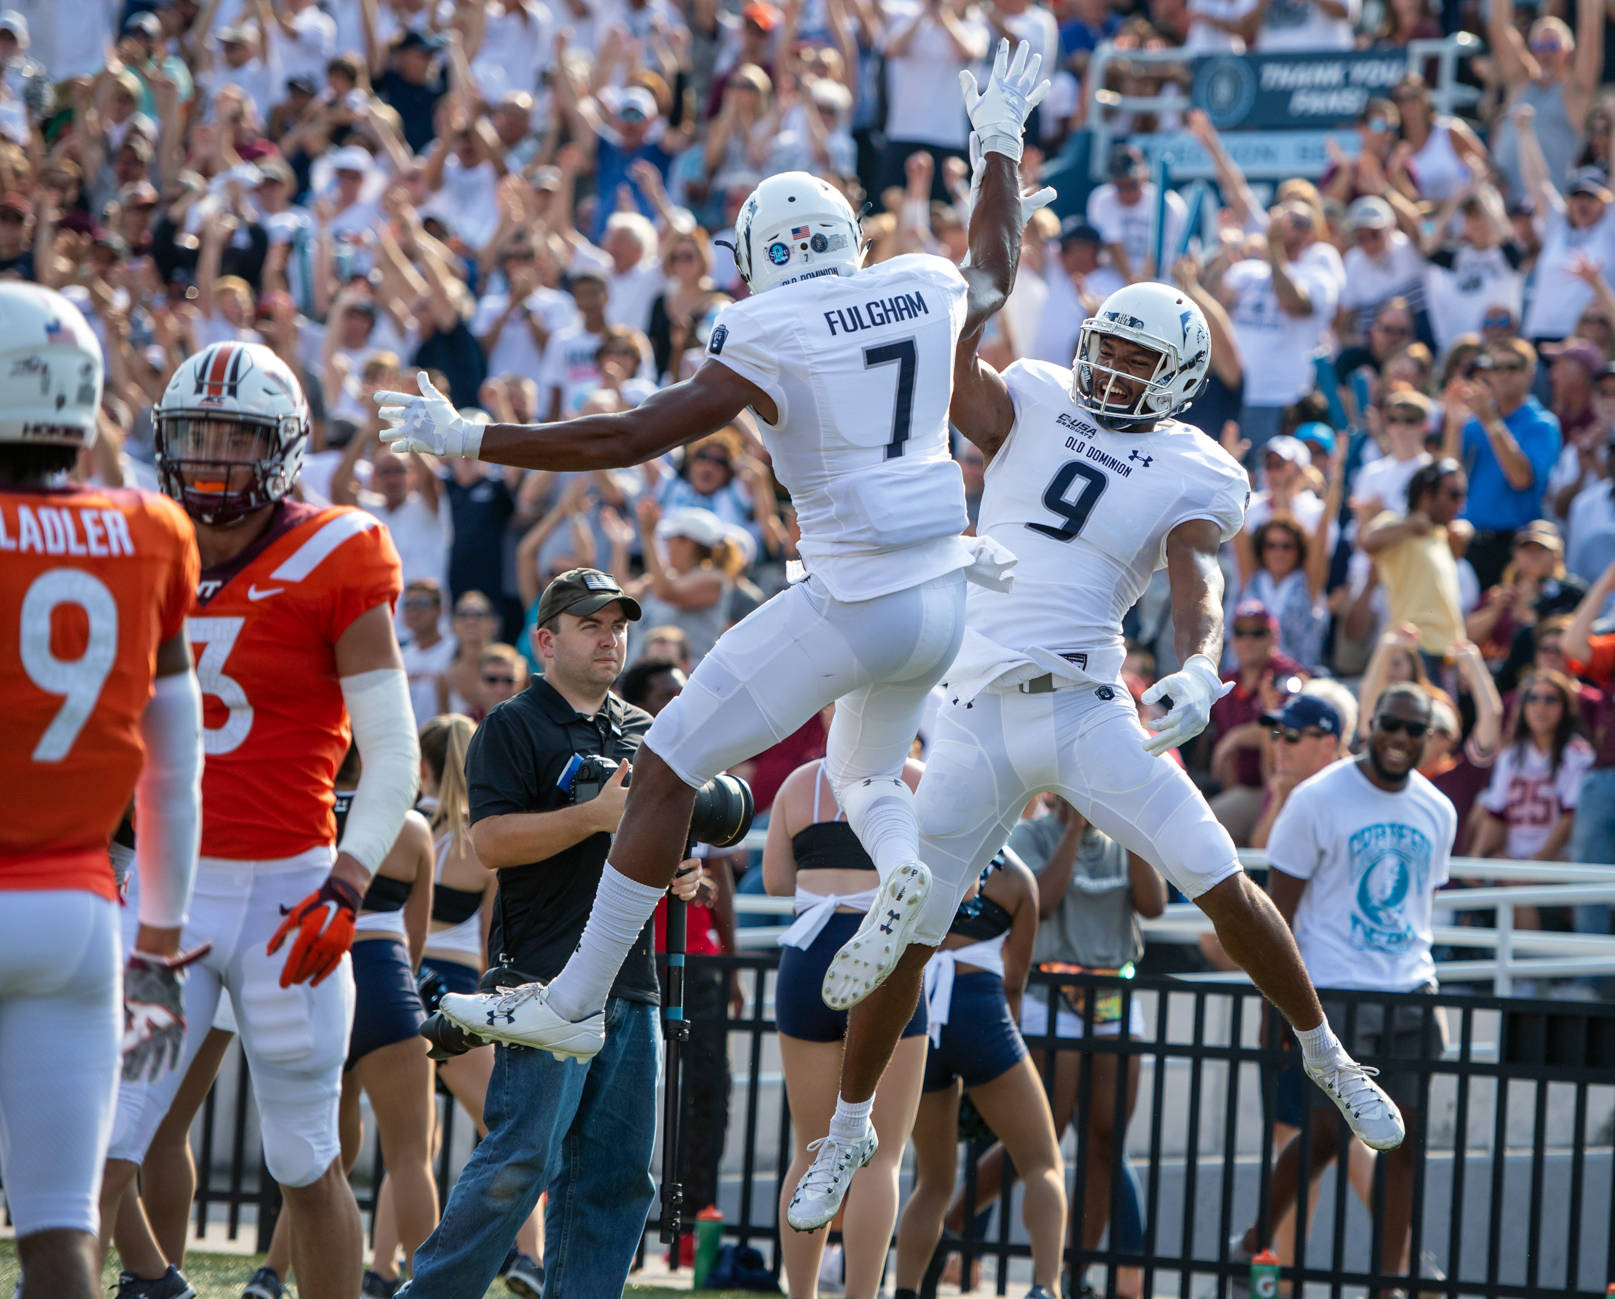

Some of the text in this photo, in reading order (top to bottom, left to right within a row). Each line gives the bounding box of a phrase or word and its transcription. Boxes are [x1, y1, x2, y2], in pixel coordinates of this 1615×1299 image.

[823, 291, 929, 336] FULGHAM
[861, 335, 919, 462] 7
[1064, 436, 1132, 478] OLD DOMINION
[0, 504, 135, 557] LADLER
[1024, 459, 1110, 543] 9
[20, 566, 118, 764] 9
[187, 616, 254, 755] 3
